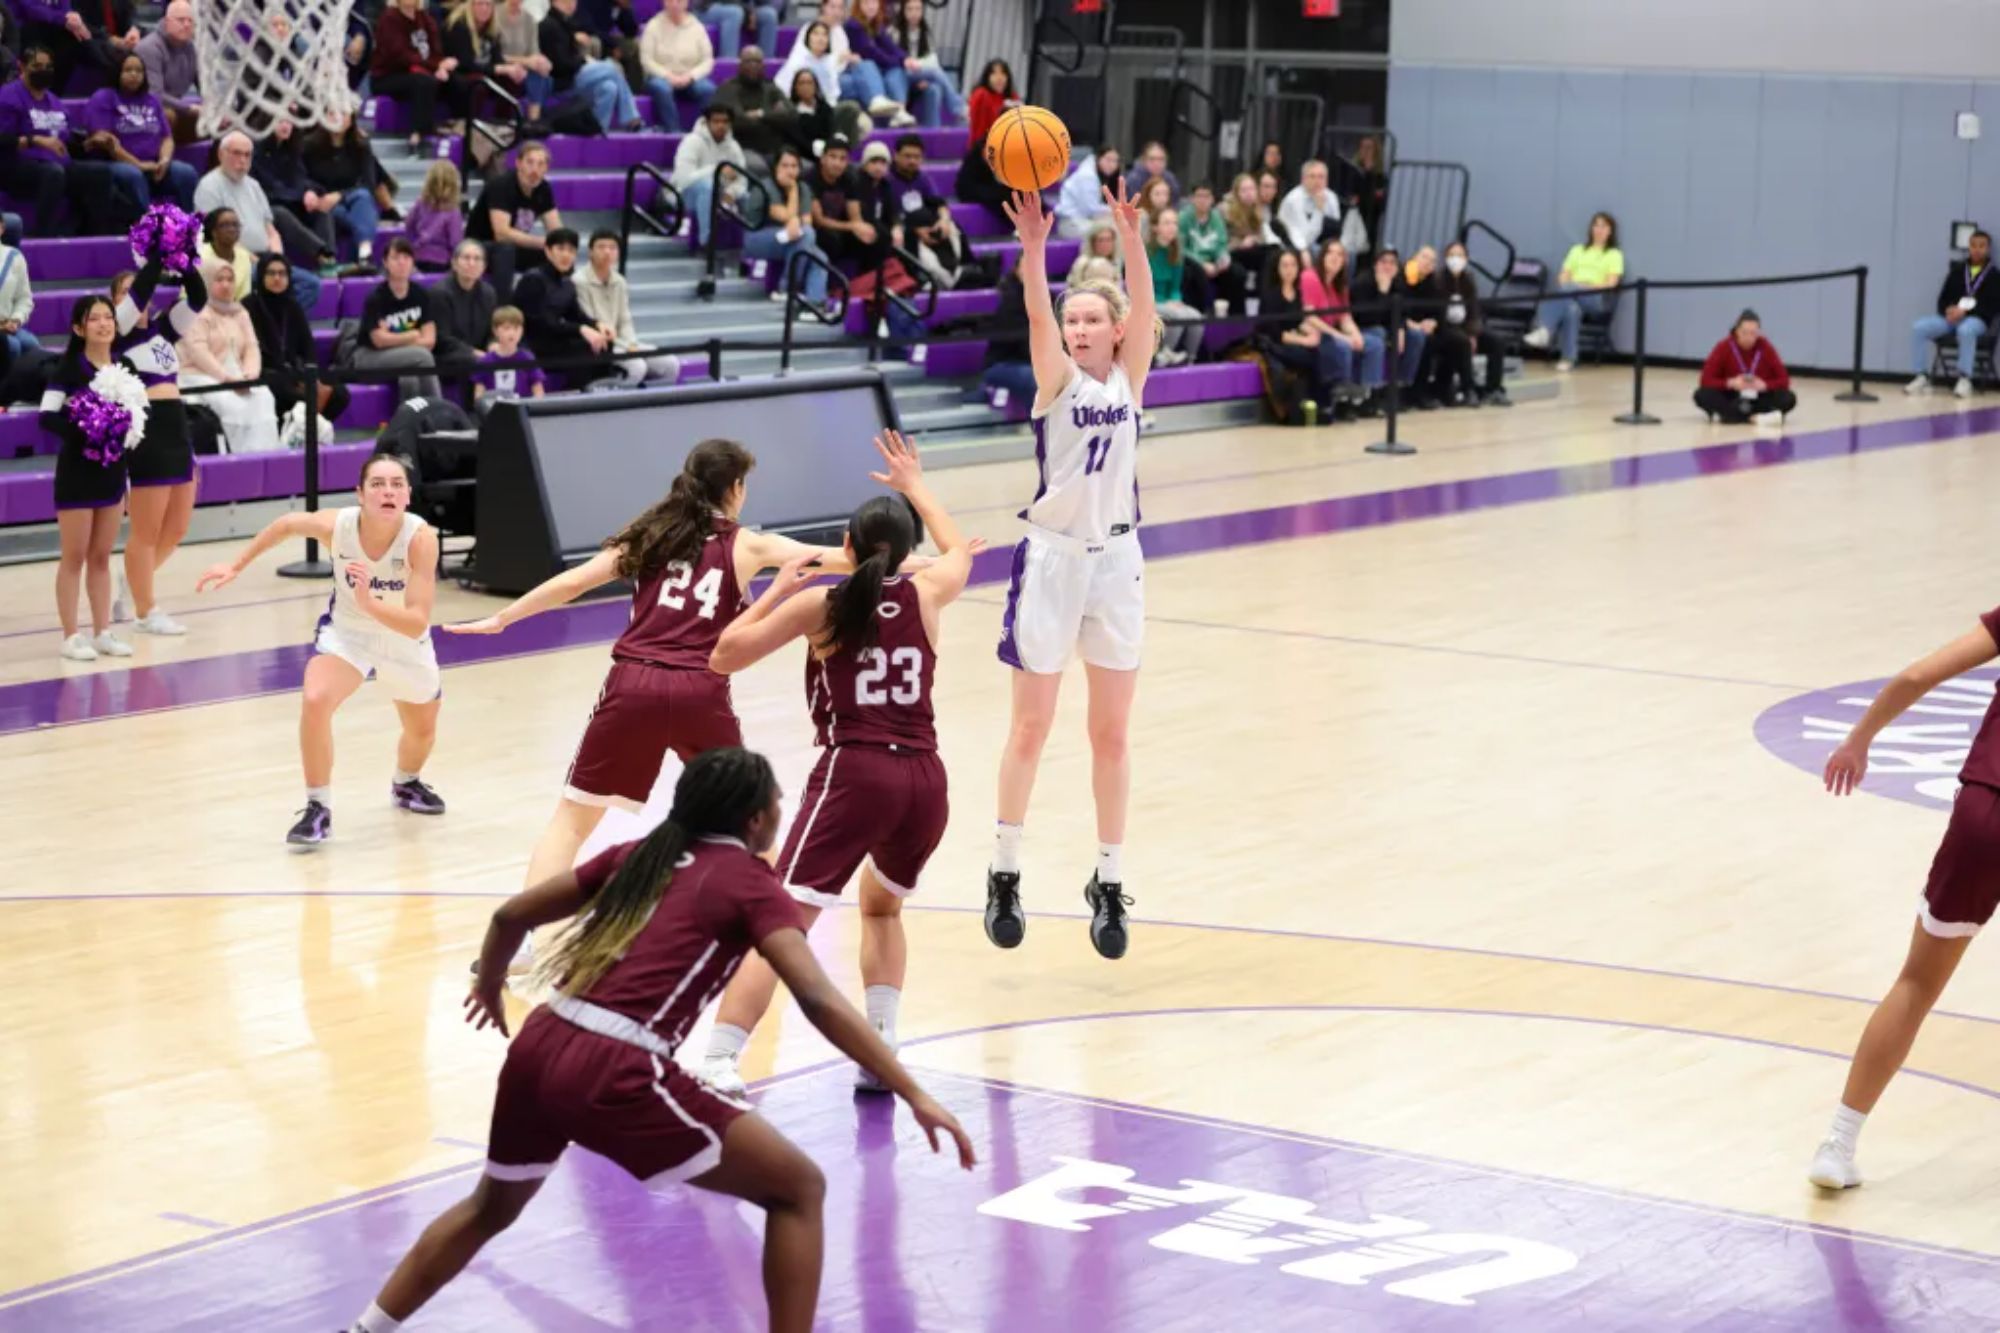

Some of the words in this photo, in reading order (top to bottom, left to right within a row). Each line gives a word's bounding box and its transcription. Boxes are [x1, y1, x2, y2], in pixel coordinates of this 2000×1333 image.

[1084, 435, 1112, 476] 11
[657, 560, 723, 620] 24
[876, 602, 902, 618] C
[855, 647, 923, 705] 23
